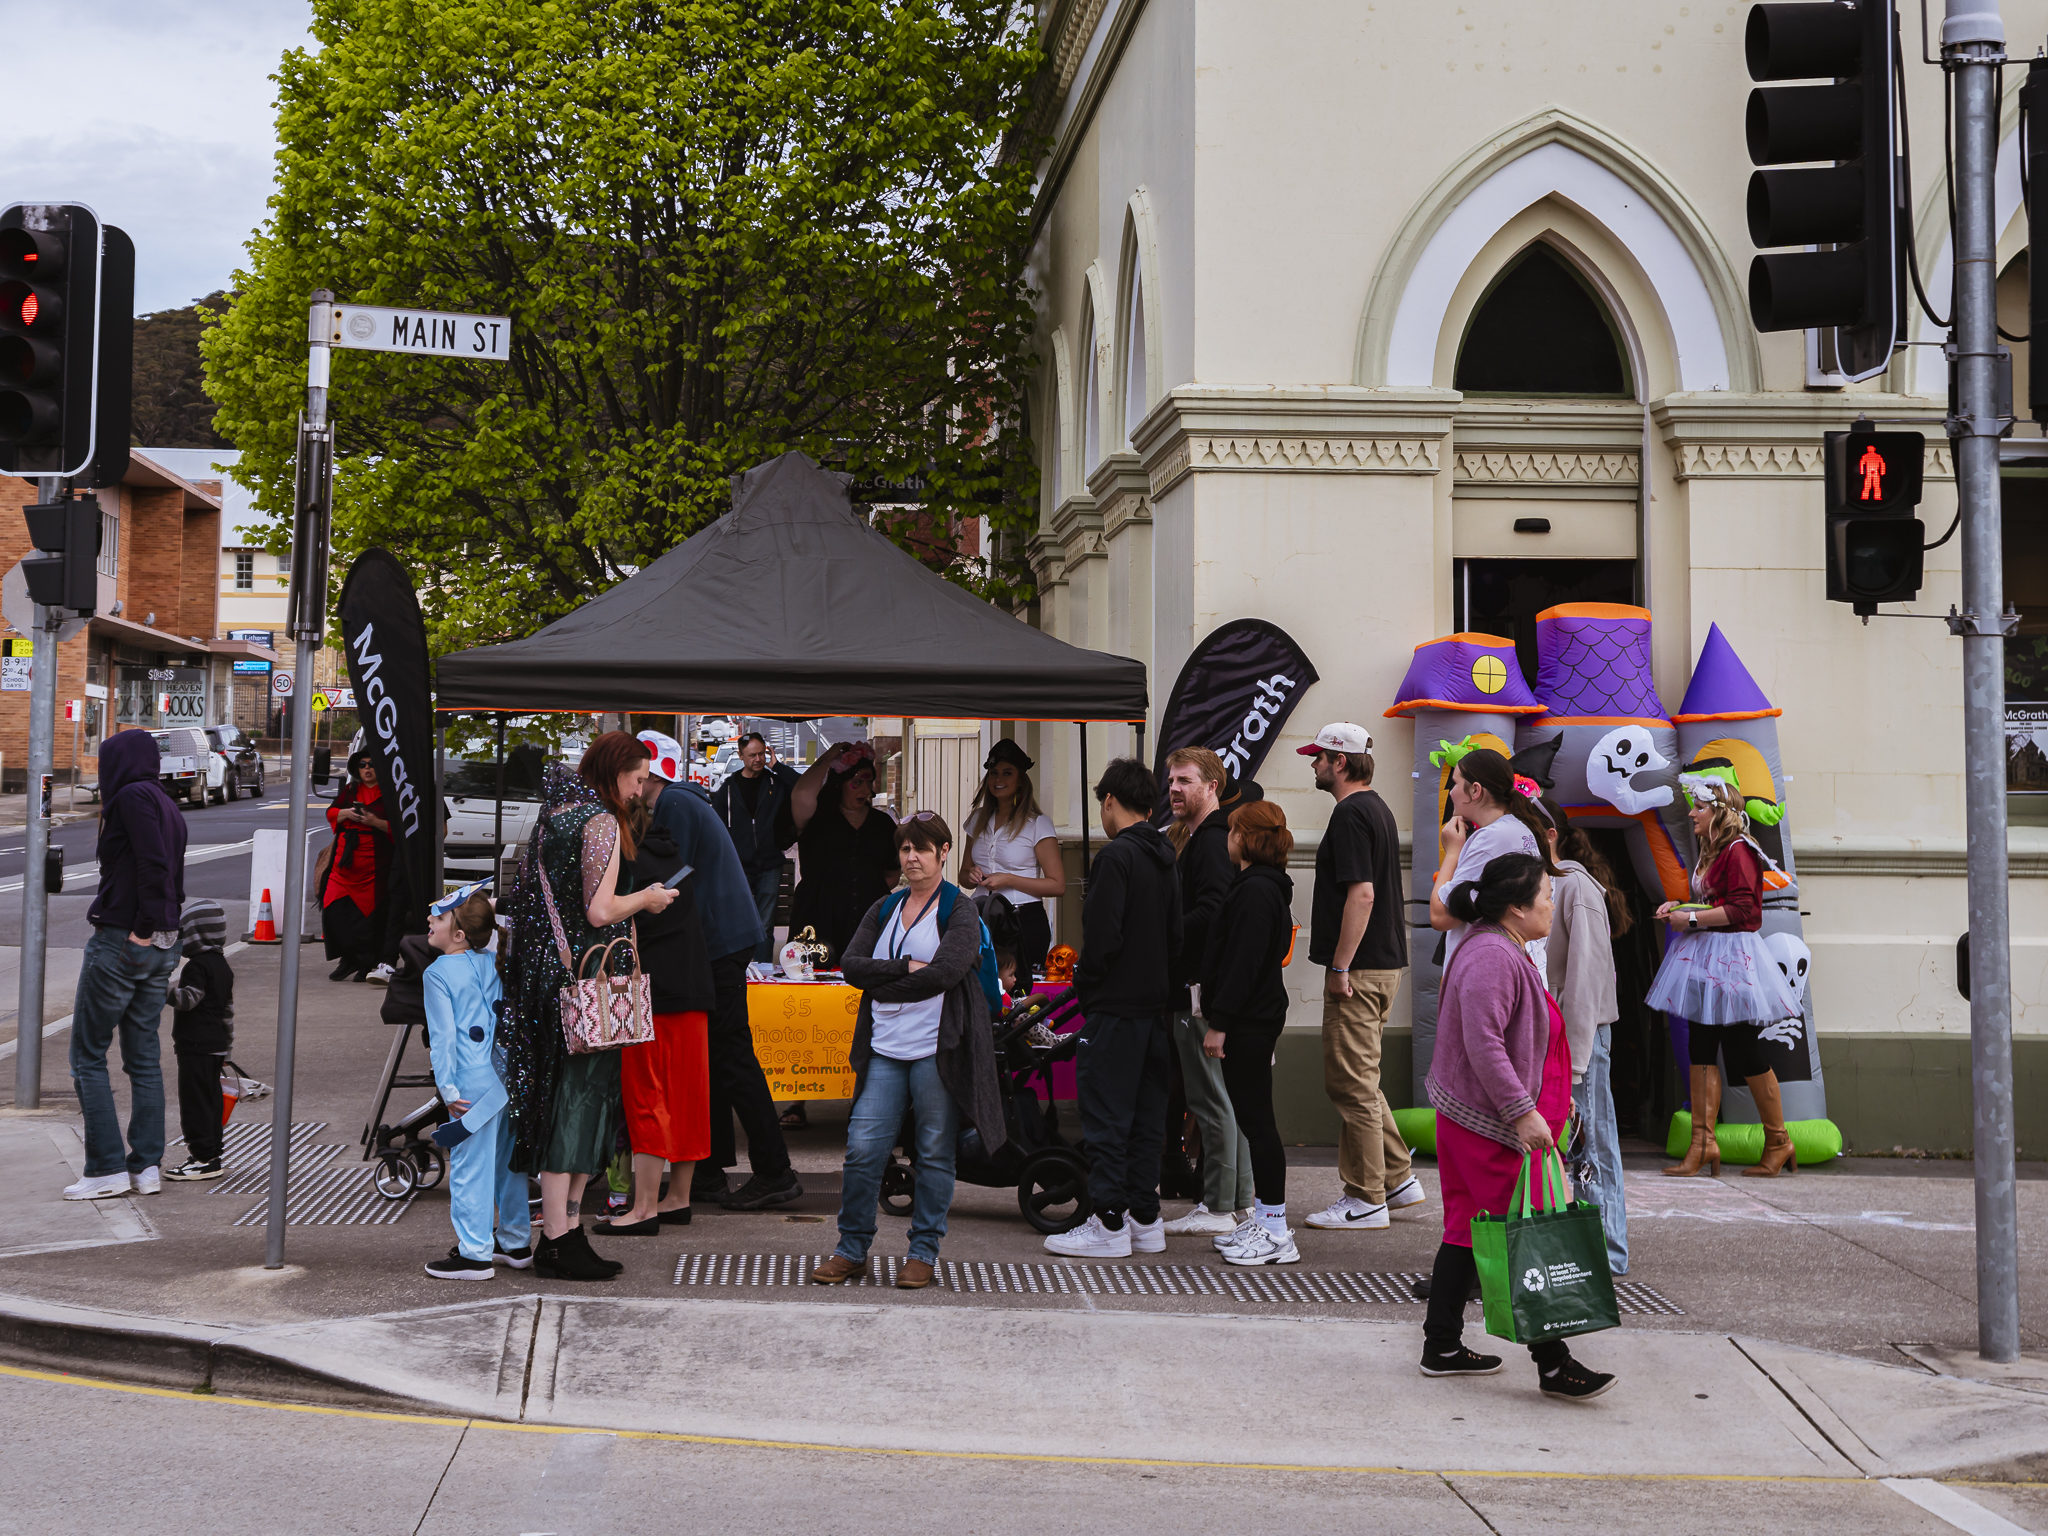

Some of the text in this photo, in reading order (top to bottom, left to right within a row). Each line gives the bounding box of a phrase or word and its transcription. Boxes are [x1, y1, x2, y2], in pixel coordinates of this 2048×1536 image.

[392, 315, 456, 349] MAIN
[472, 321, 501, 353] ST
[147, 668, 175, 681] SIRENS
[165, 684, 202, 692] HEAVEN
[276, 678, 290, 688] 50
[352, 622, 420, 839] McGrath
[783, 995, 812, 1019] $5
[755, 1045, 813, 1064] Goes
[772, 1081, 826, 1095] Projects
